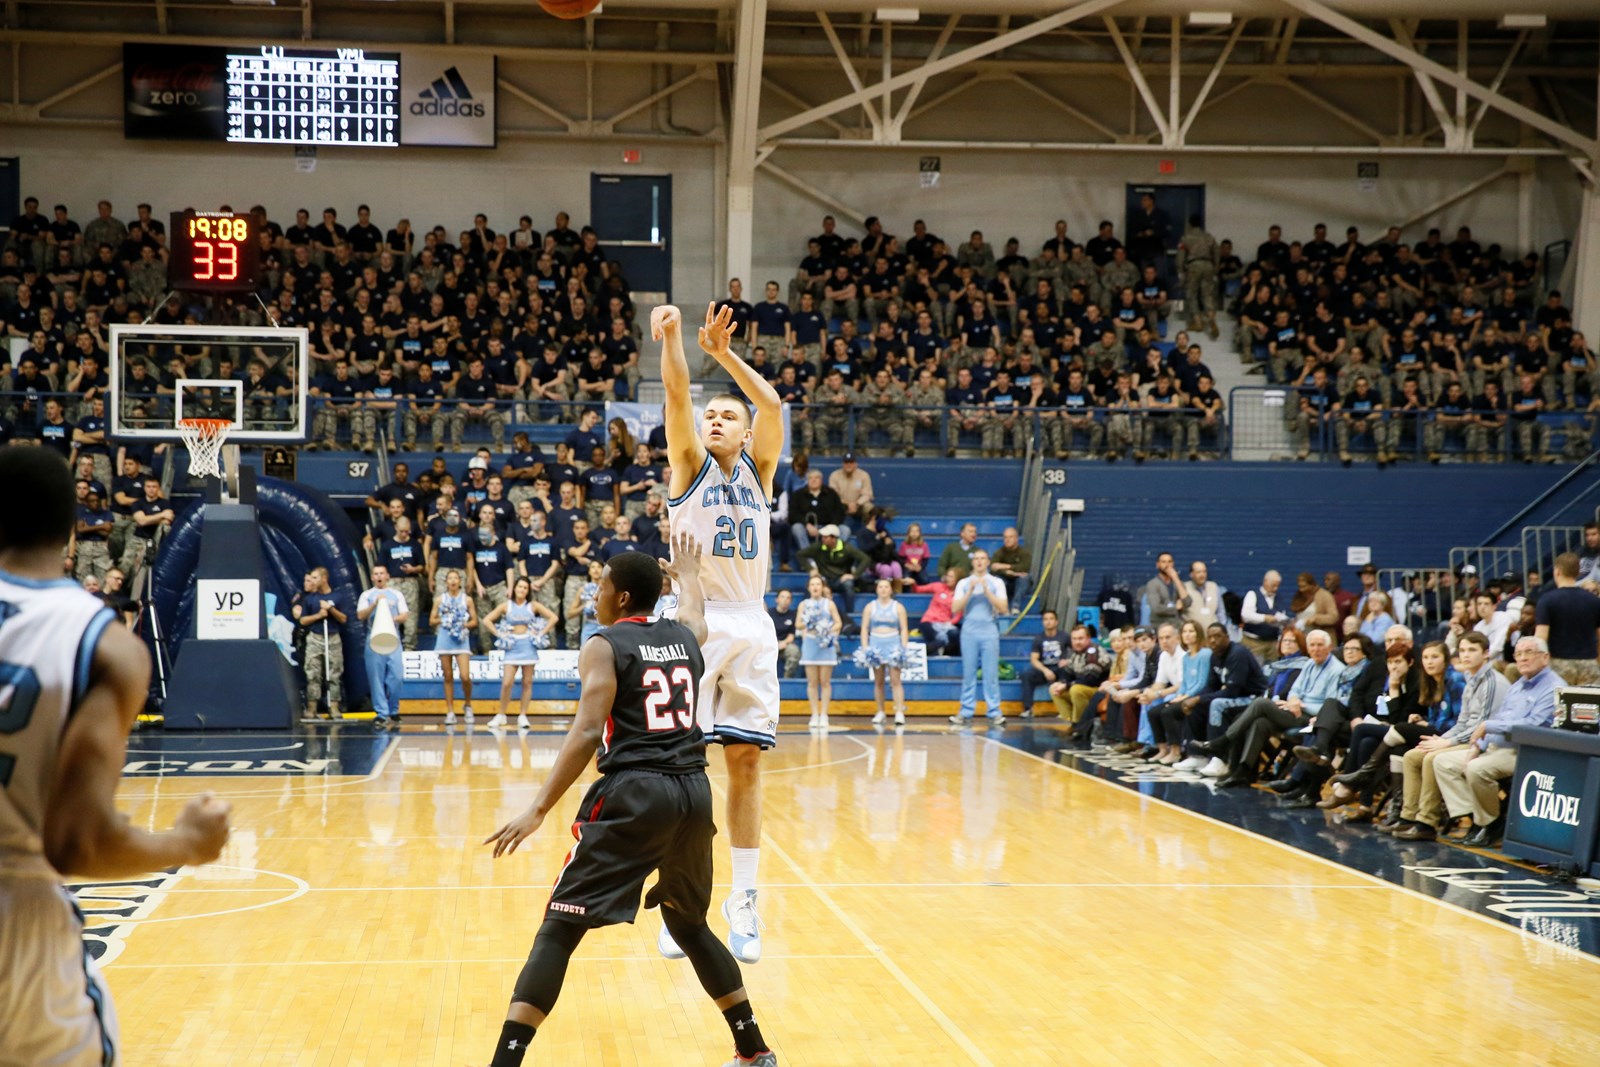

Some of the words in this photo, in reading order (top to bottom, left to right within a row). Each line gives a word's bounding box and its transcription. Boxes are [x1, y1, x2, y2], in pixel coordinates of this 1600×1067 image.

[251, 86, 259, 96] 0
[278, 87, 286, 98] 0
[300, 88, 308, 99] 0
[340, 89, 347, 100] 0
[366, 90, 373, 101] 0
[386, 90, 393, 101] 0
[254, 101, 262, 112] 0
[278, 102, 286, 113] 0
[300, 103, 308, 113] 0
[366, 104, 373, 115] 0
[410, 98, 485, 117] adidas
[254, 115, 262, 126] 0
[300, 117, 308, 128] 0
[340, 118, 348, 129] 0
[366, 119, 373, 130] 0
[300, 130, 308, 140] 0
[190, 218, 247, 241] 19:08
[194, 242, 237, 279] 33
[349, 462, 369, 477] 37
[1045, 470, 1065, 484] 38
[712, 515, 758, 559] 20
[215, 592, 244, 610] yp
[642, 665, 694, 731] 23
[1539, 774, 1556, 791] THE
[1519, 770, 1581, 826] CITADEL
[550, 901, 586, 915] KEYDETS
